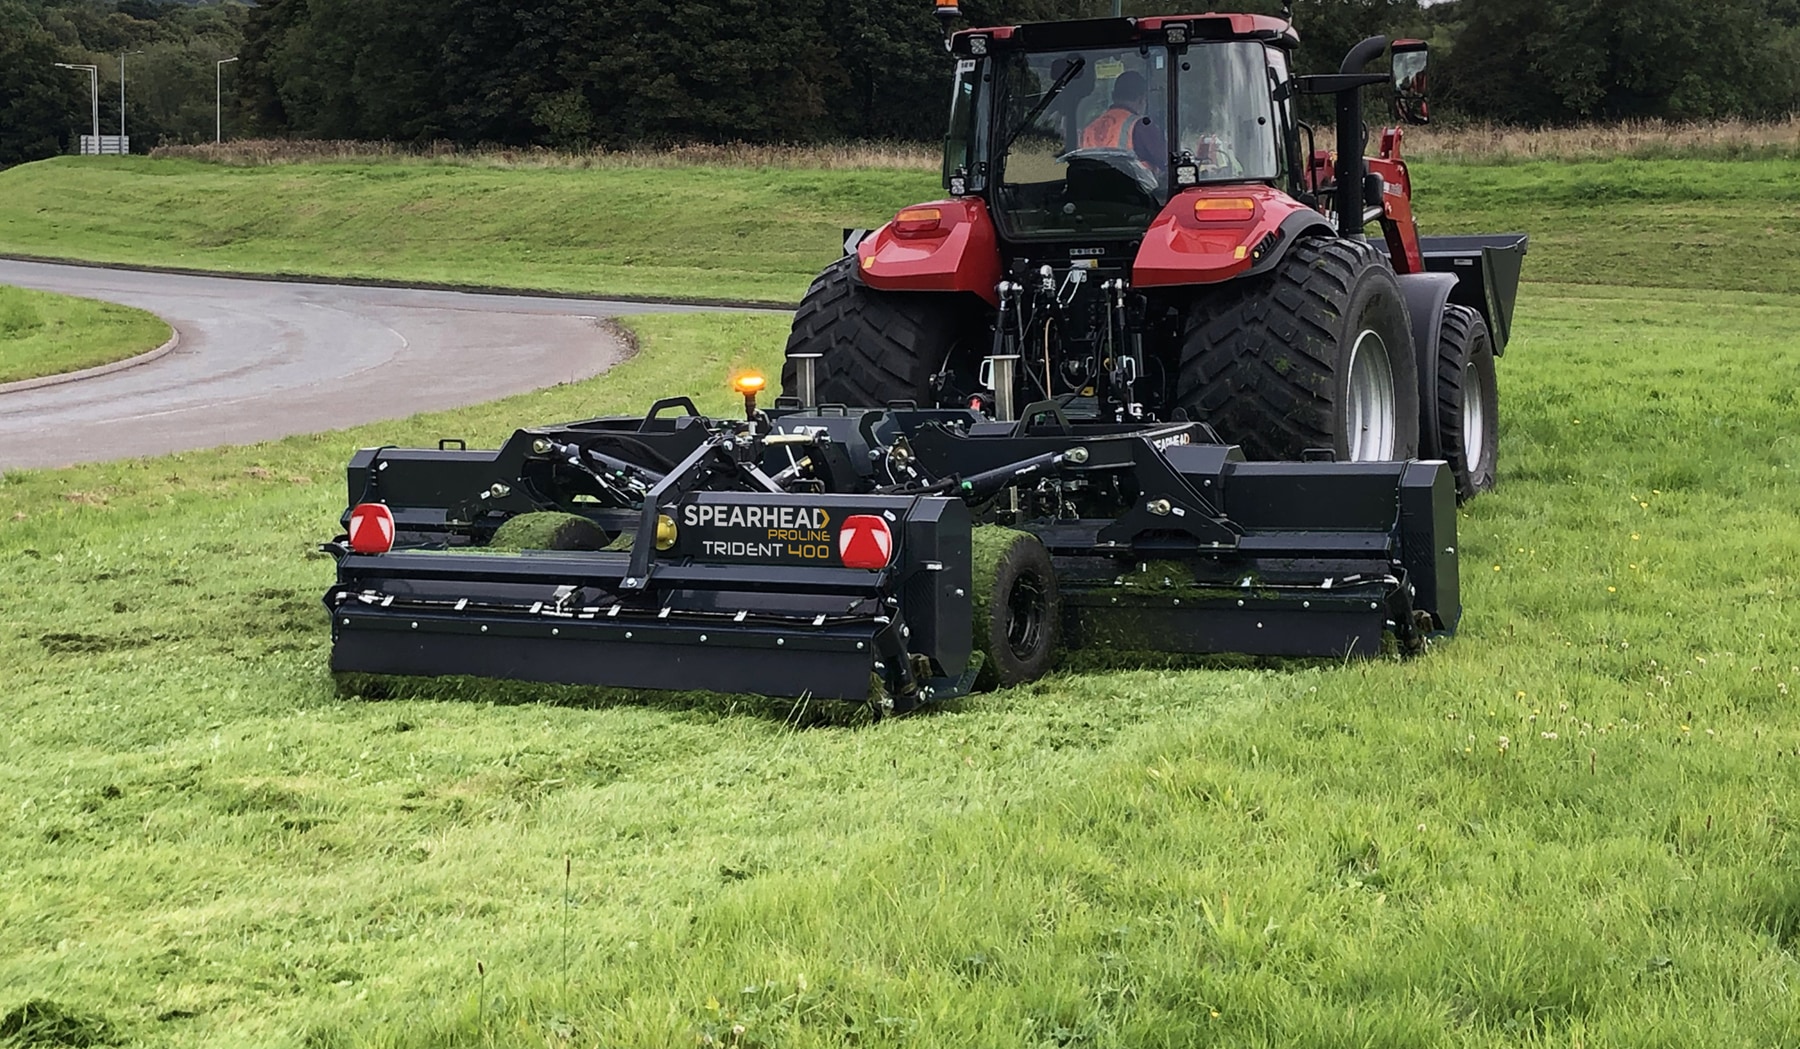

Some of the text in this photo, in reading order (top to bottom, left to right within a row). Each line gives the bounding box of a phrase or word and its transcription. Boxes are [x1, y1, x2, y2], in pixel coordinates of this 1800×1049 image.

[684, 505, 831, 529] SPEARHEAD
[768, 529, 831, 542] PROLINE
[702, 541, 830, 559] TRIDENT 400
